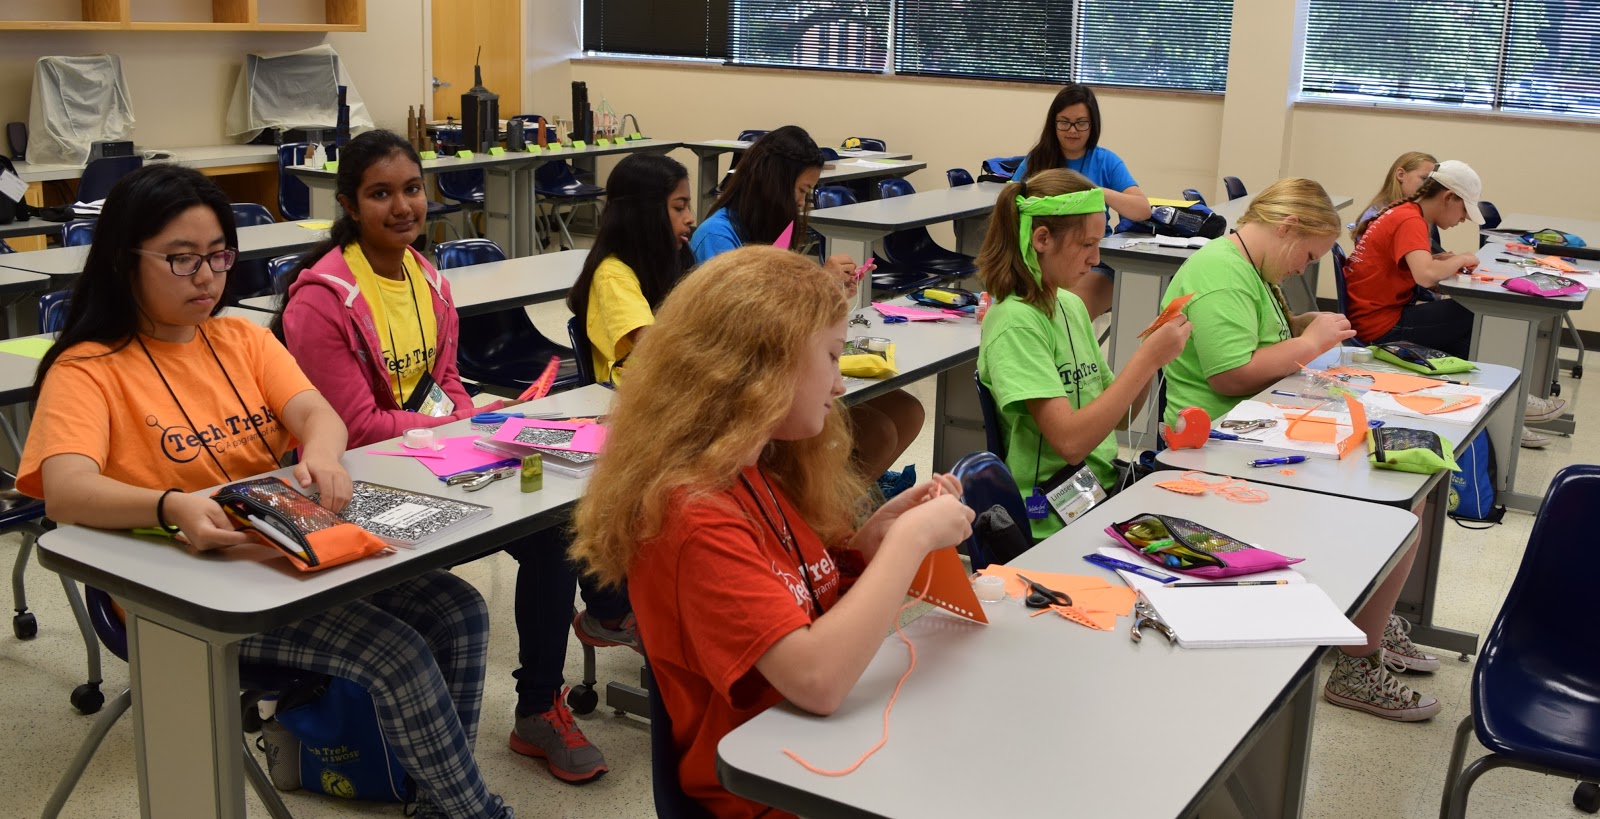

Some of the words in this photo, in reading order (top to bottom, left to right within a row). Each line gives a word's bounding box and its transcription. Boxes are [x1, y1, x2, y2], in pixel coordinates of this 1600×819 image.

[413, 347, 435, 364] Tre
[168, 423, 226, 452] Tech
[225, 406, 277, 435] Trek
[1051, 482, 1075, 502] Lindsey
[322, 745, 348, 756] Trek
